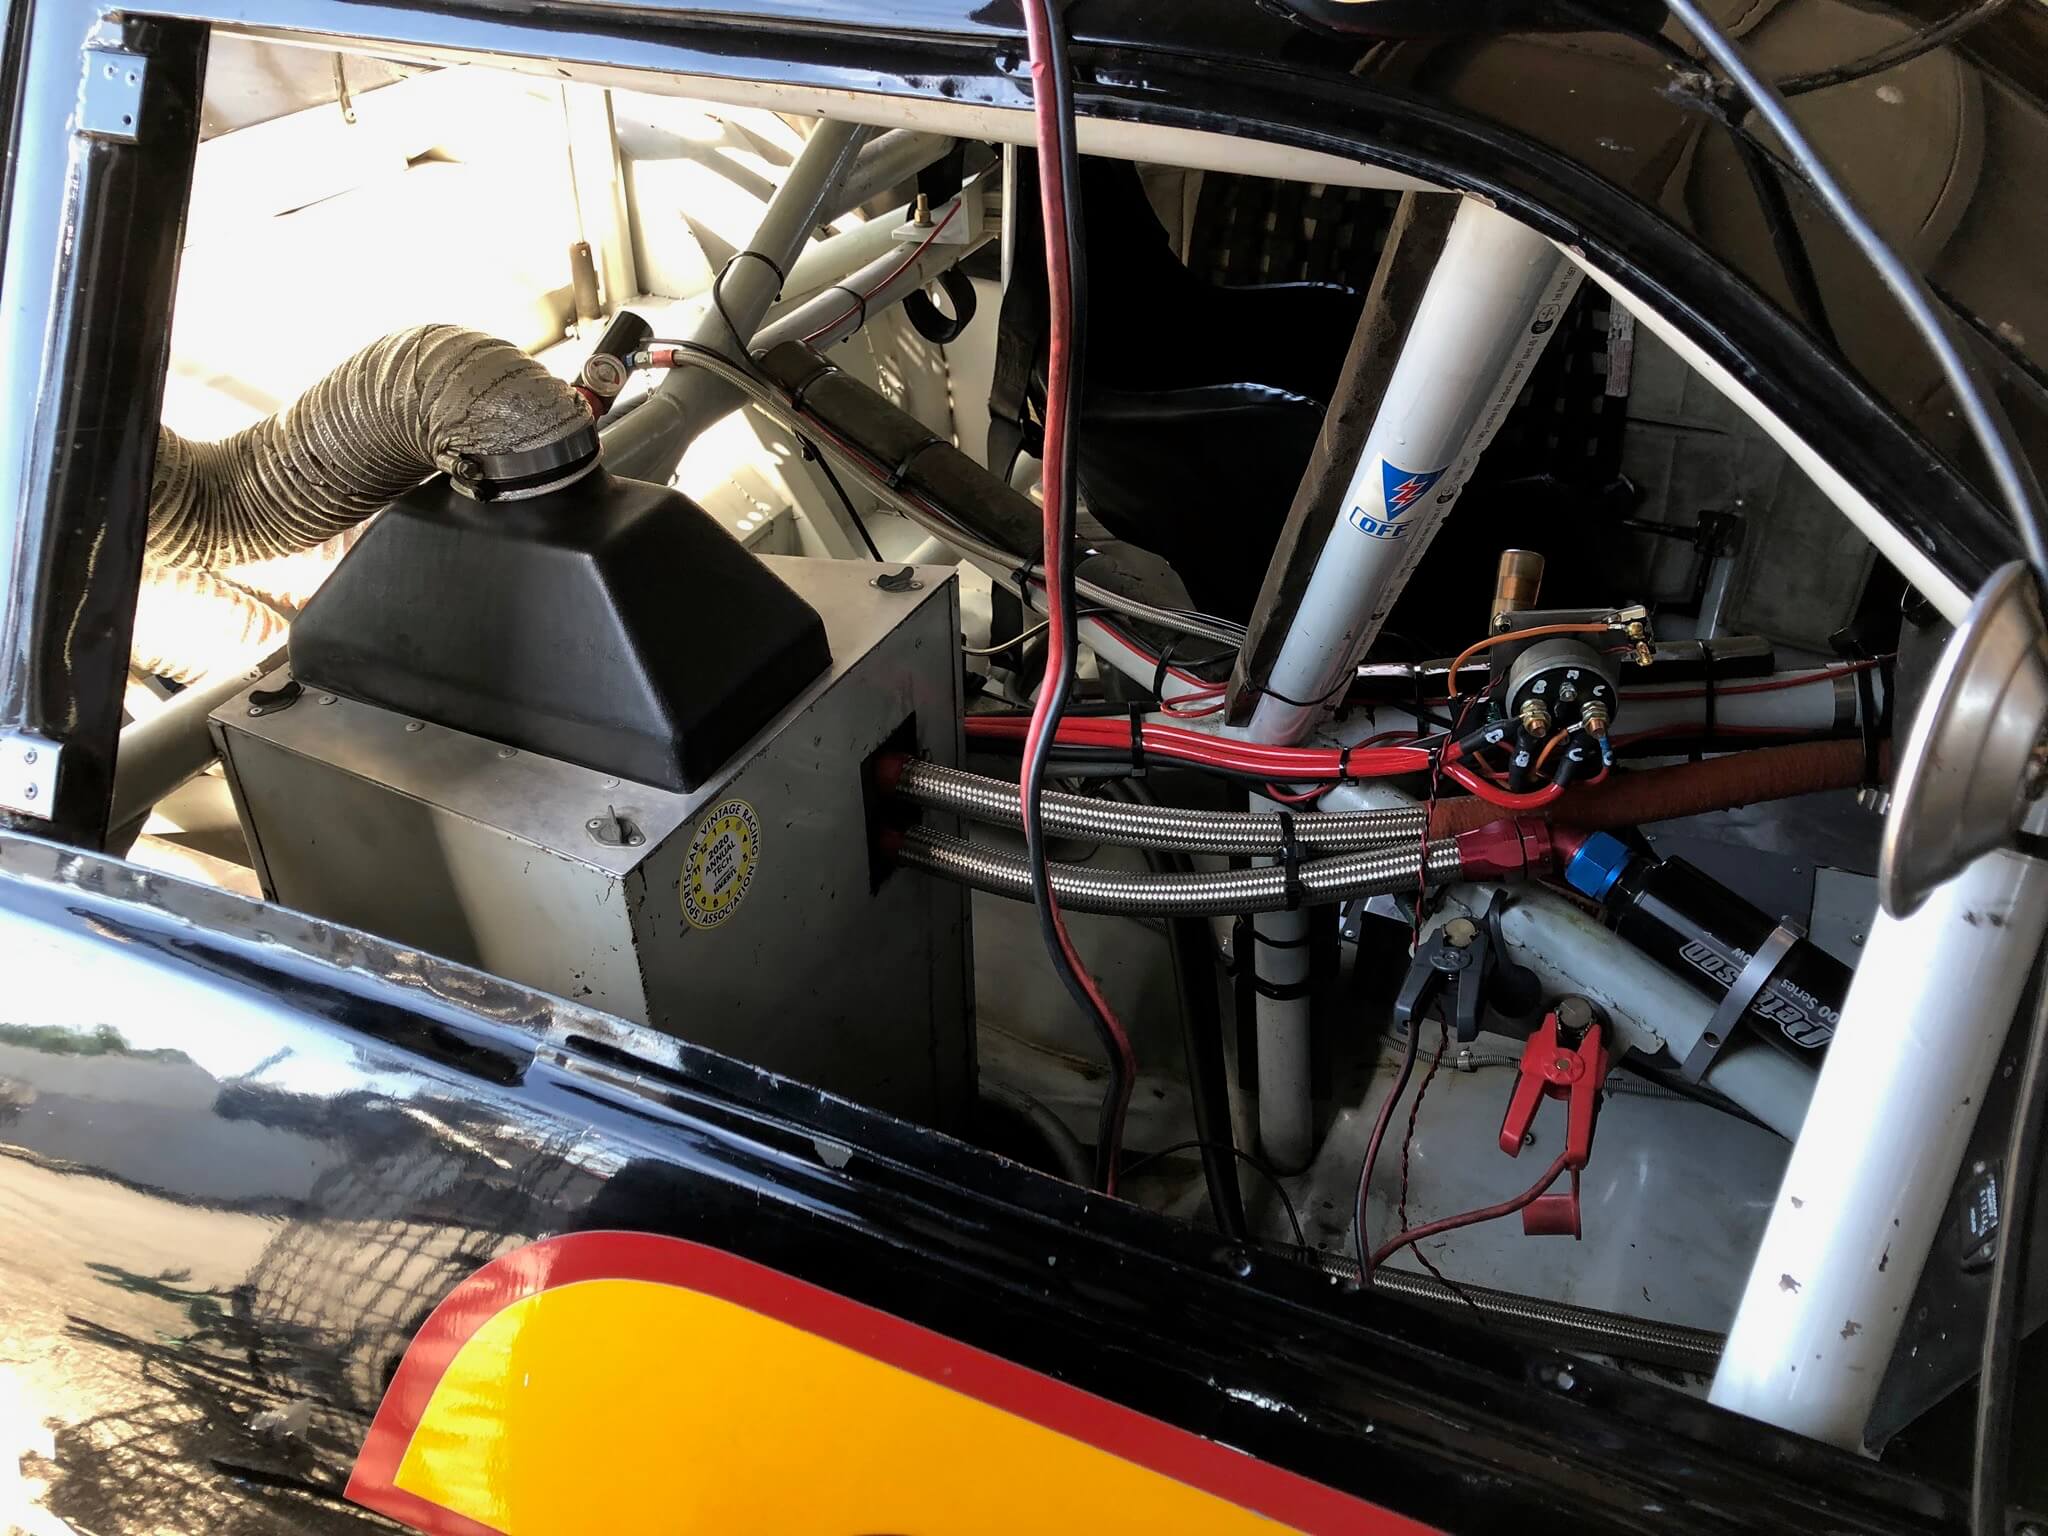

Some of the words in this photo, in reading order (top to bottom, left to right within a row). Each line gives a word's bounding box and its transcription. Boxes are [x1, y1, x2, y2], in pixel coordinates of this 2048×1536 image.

[1360, 517, 1410, 537] OFF
[683, 841, 701, 920] SPORTSCAR
[700, 803, 742, 835] VINTAGE
[741, 808, 759, 857] RACING
[705, 840, 736, 876] ANNUAL
[708, 834, 729, 861] 2020
[712, 853, 732, 878] TECH
[701, 865, 755, 925] ASSOCIATION
[1780, 978, 1818, 1010] Series
